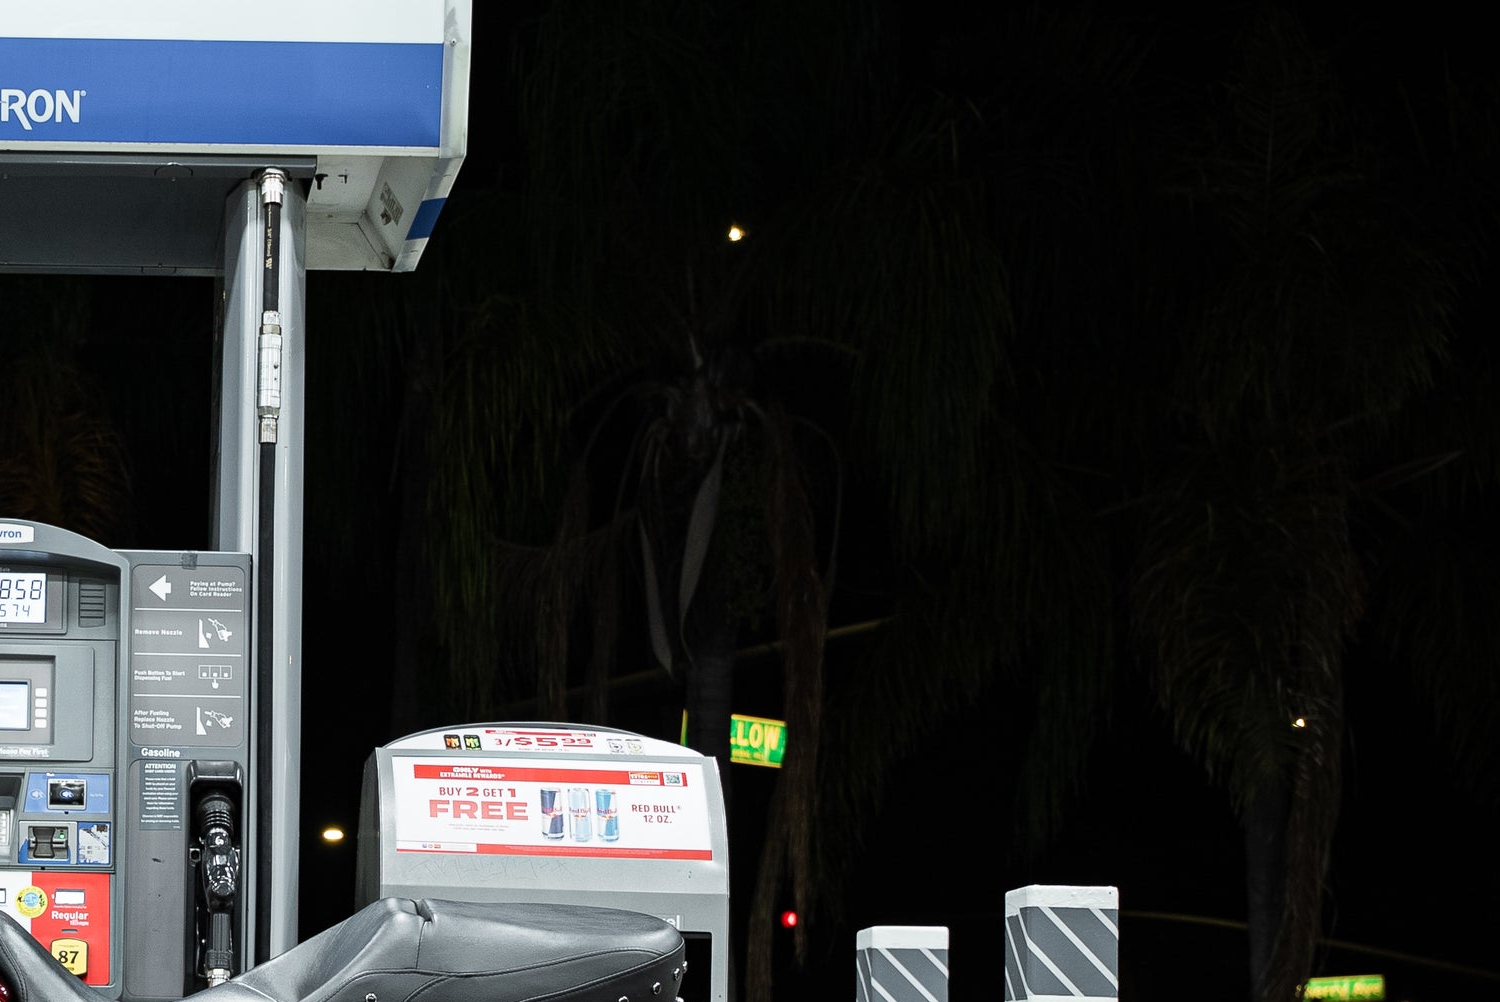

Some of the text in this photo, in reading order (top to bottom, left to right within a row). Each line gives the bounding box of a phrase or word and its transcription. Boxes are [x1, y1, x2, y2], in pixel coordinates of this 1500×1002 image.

[141, 748, 180, 757] Gasoline
[439, 787, 516, 797] BUY 2 GET 1
[429, 799, 528, 820] FREE
[632, 804, 650, 812] RED
[657, 815, 672, 823] OZ.
[51, 911, 88, 921] Regular
[58, 950, 79, 964] 87
